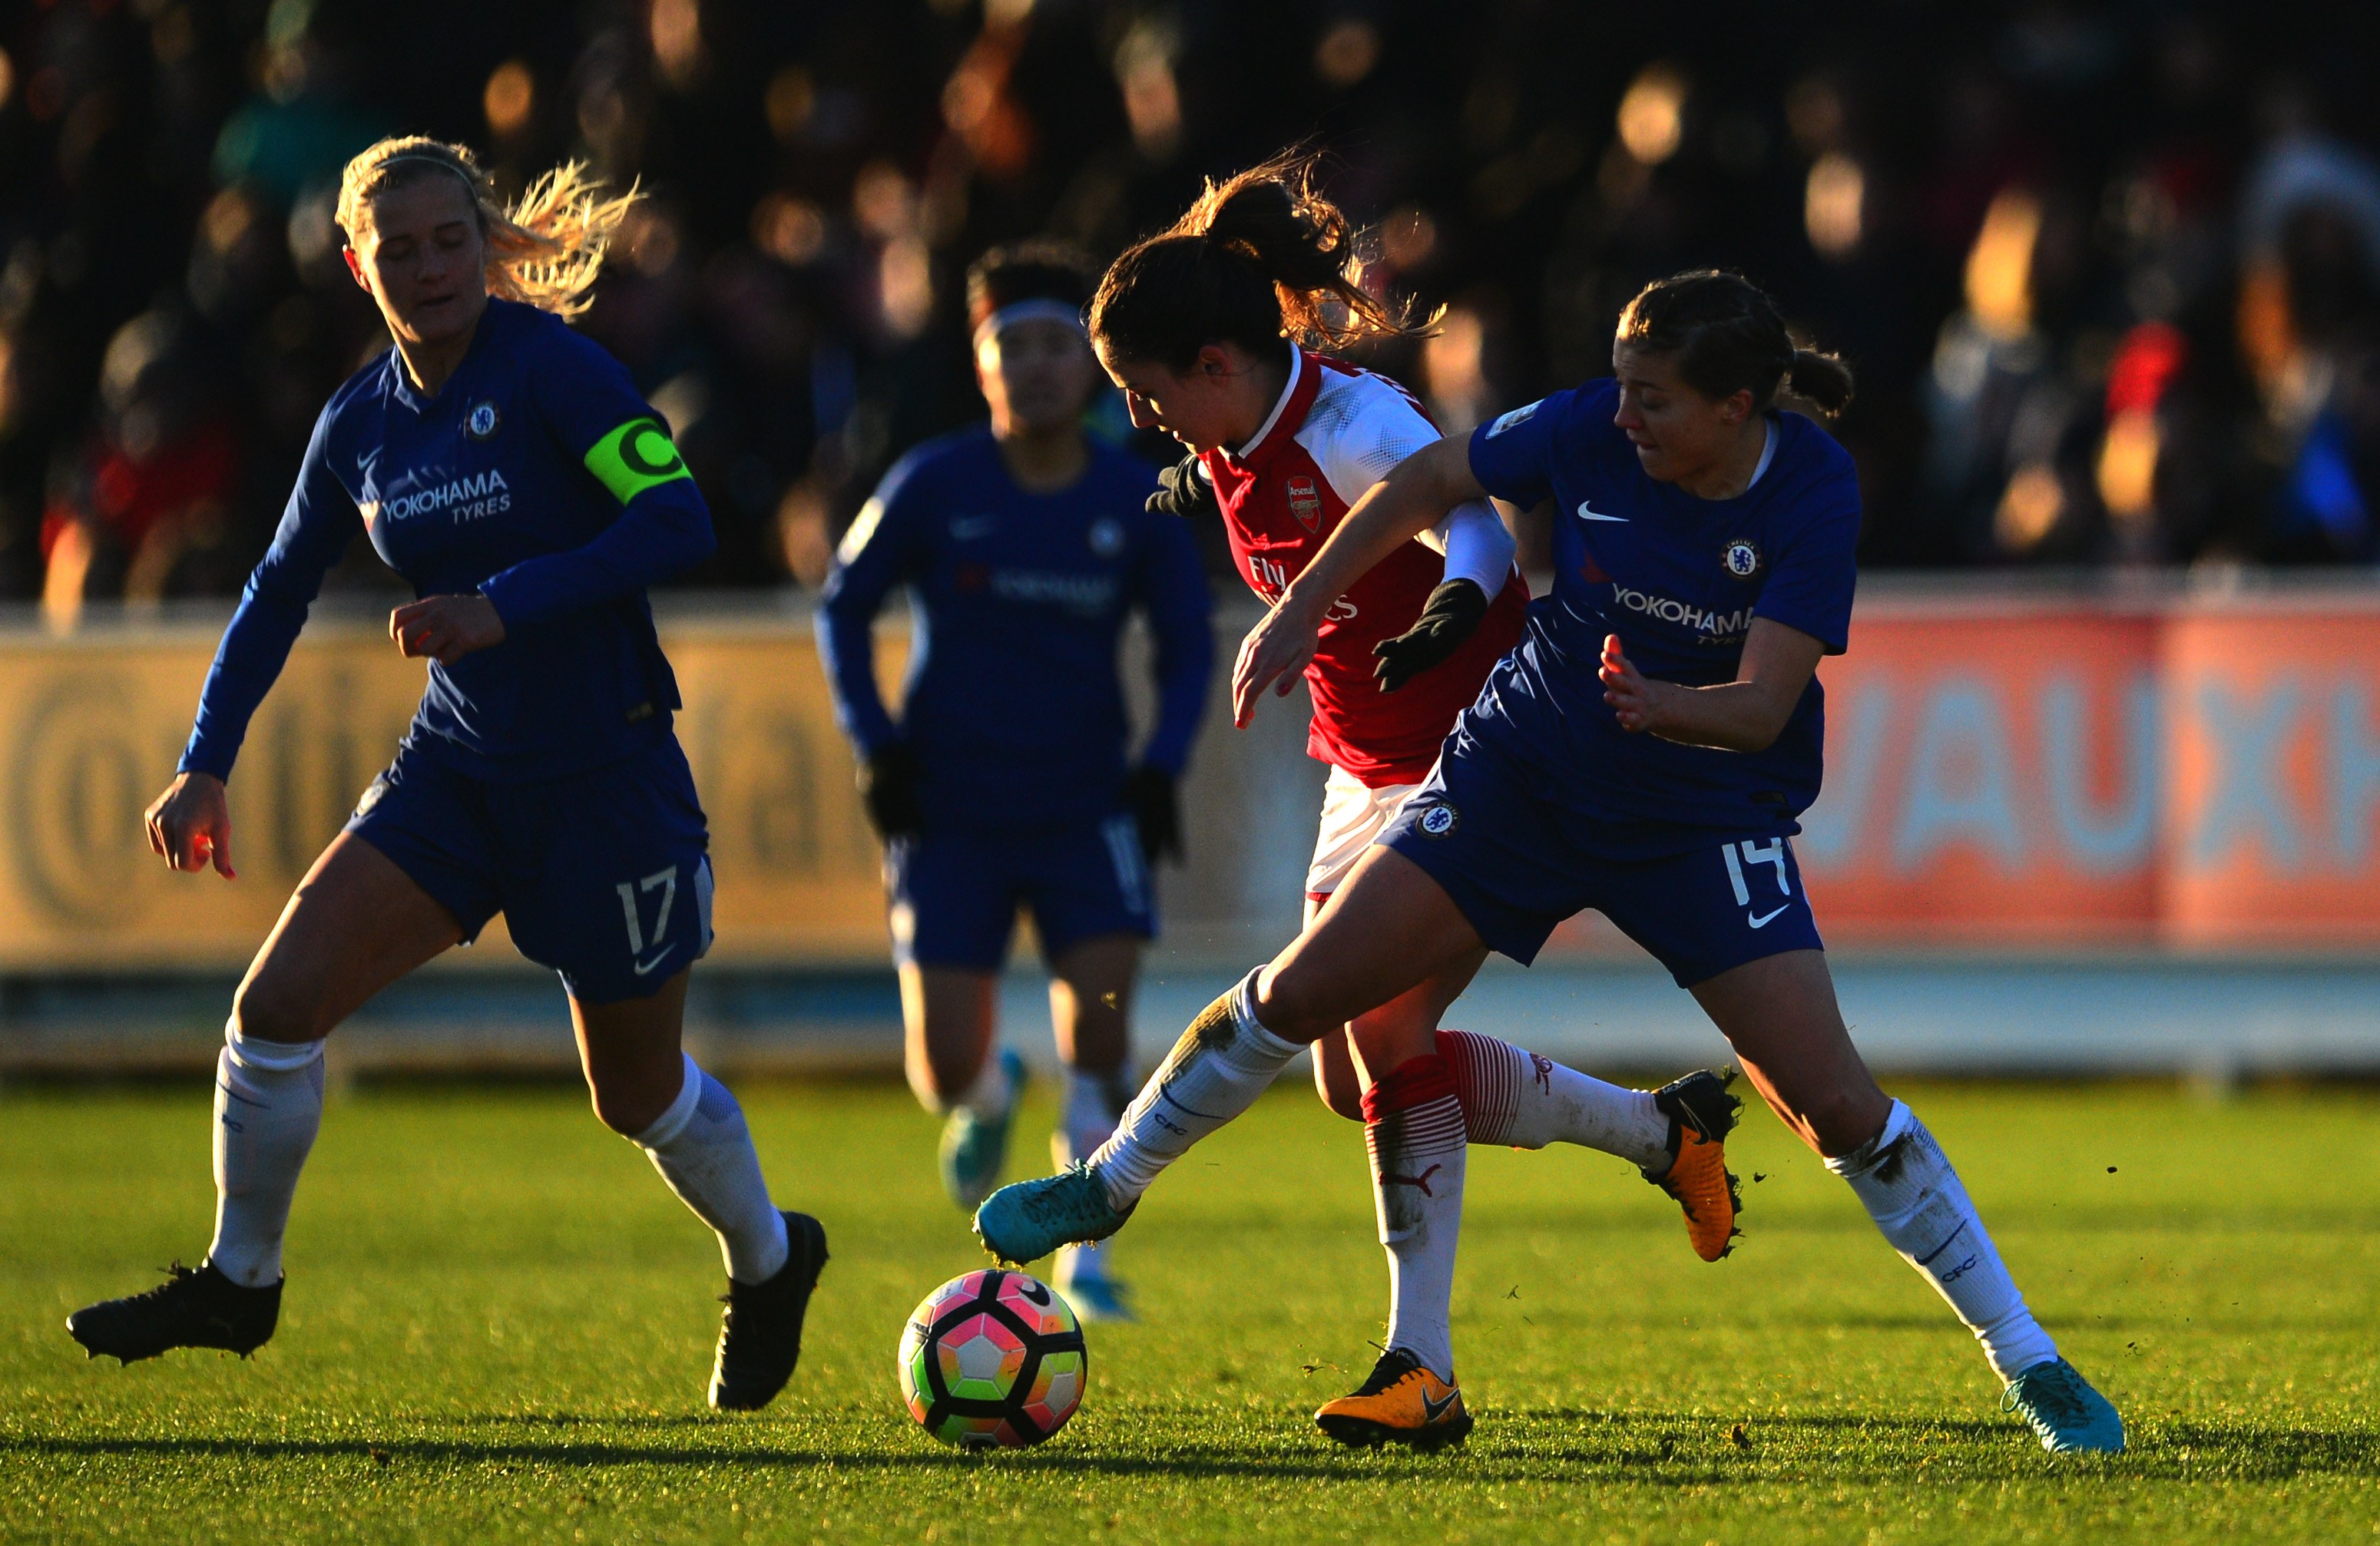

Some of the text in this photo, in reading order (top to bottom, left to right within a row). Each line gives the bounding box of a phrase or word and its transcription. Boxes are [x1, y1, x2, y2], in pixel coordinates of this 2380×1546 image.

[382, 468, 508, 523] YOKOHAMA
[1290, 485, 1315, 496] Arsenal
[452, 494, 511, 525] TYRES
[1248, 555, 1286, 591] Fly
[1722, 837, 1790, 905] 14
[616, 865, 677, 955] 17
[1154, 1114, 1187, 1136] CFC
[1941, 1254, 1977, 1283] CFC
